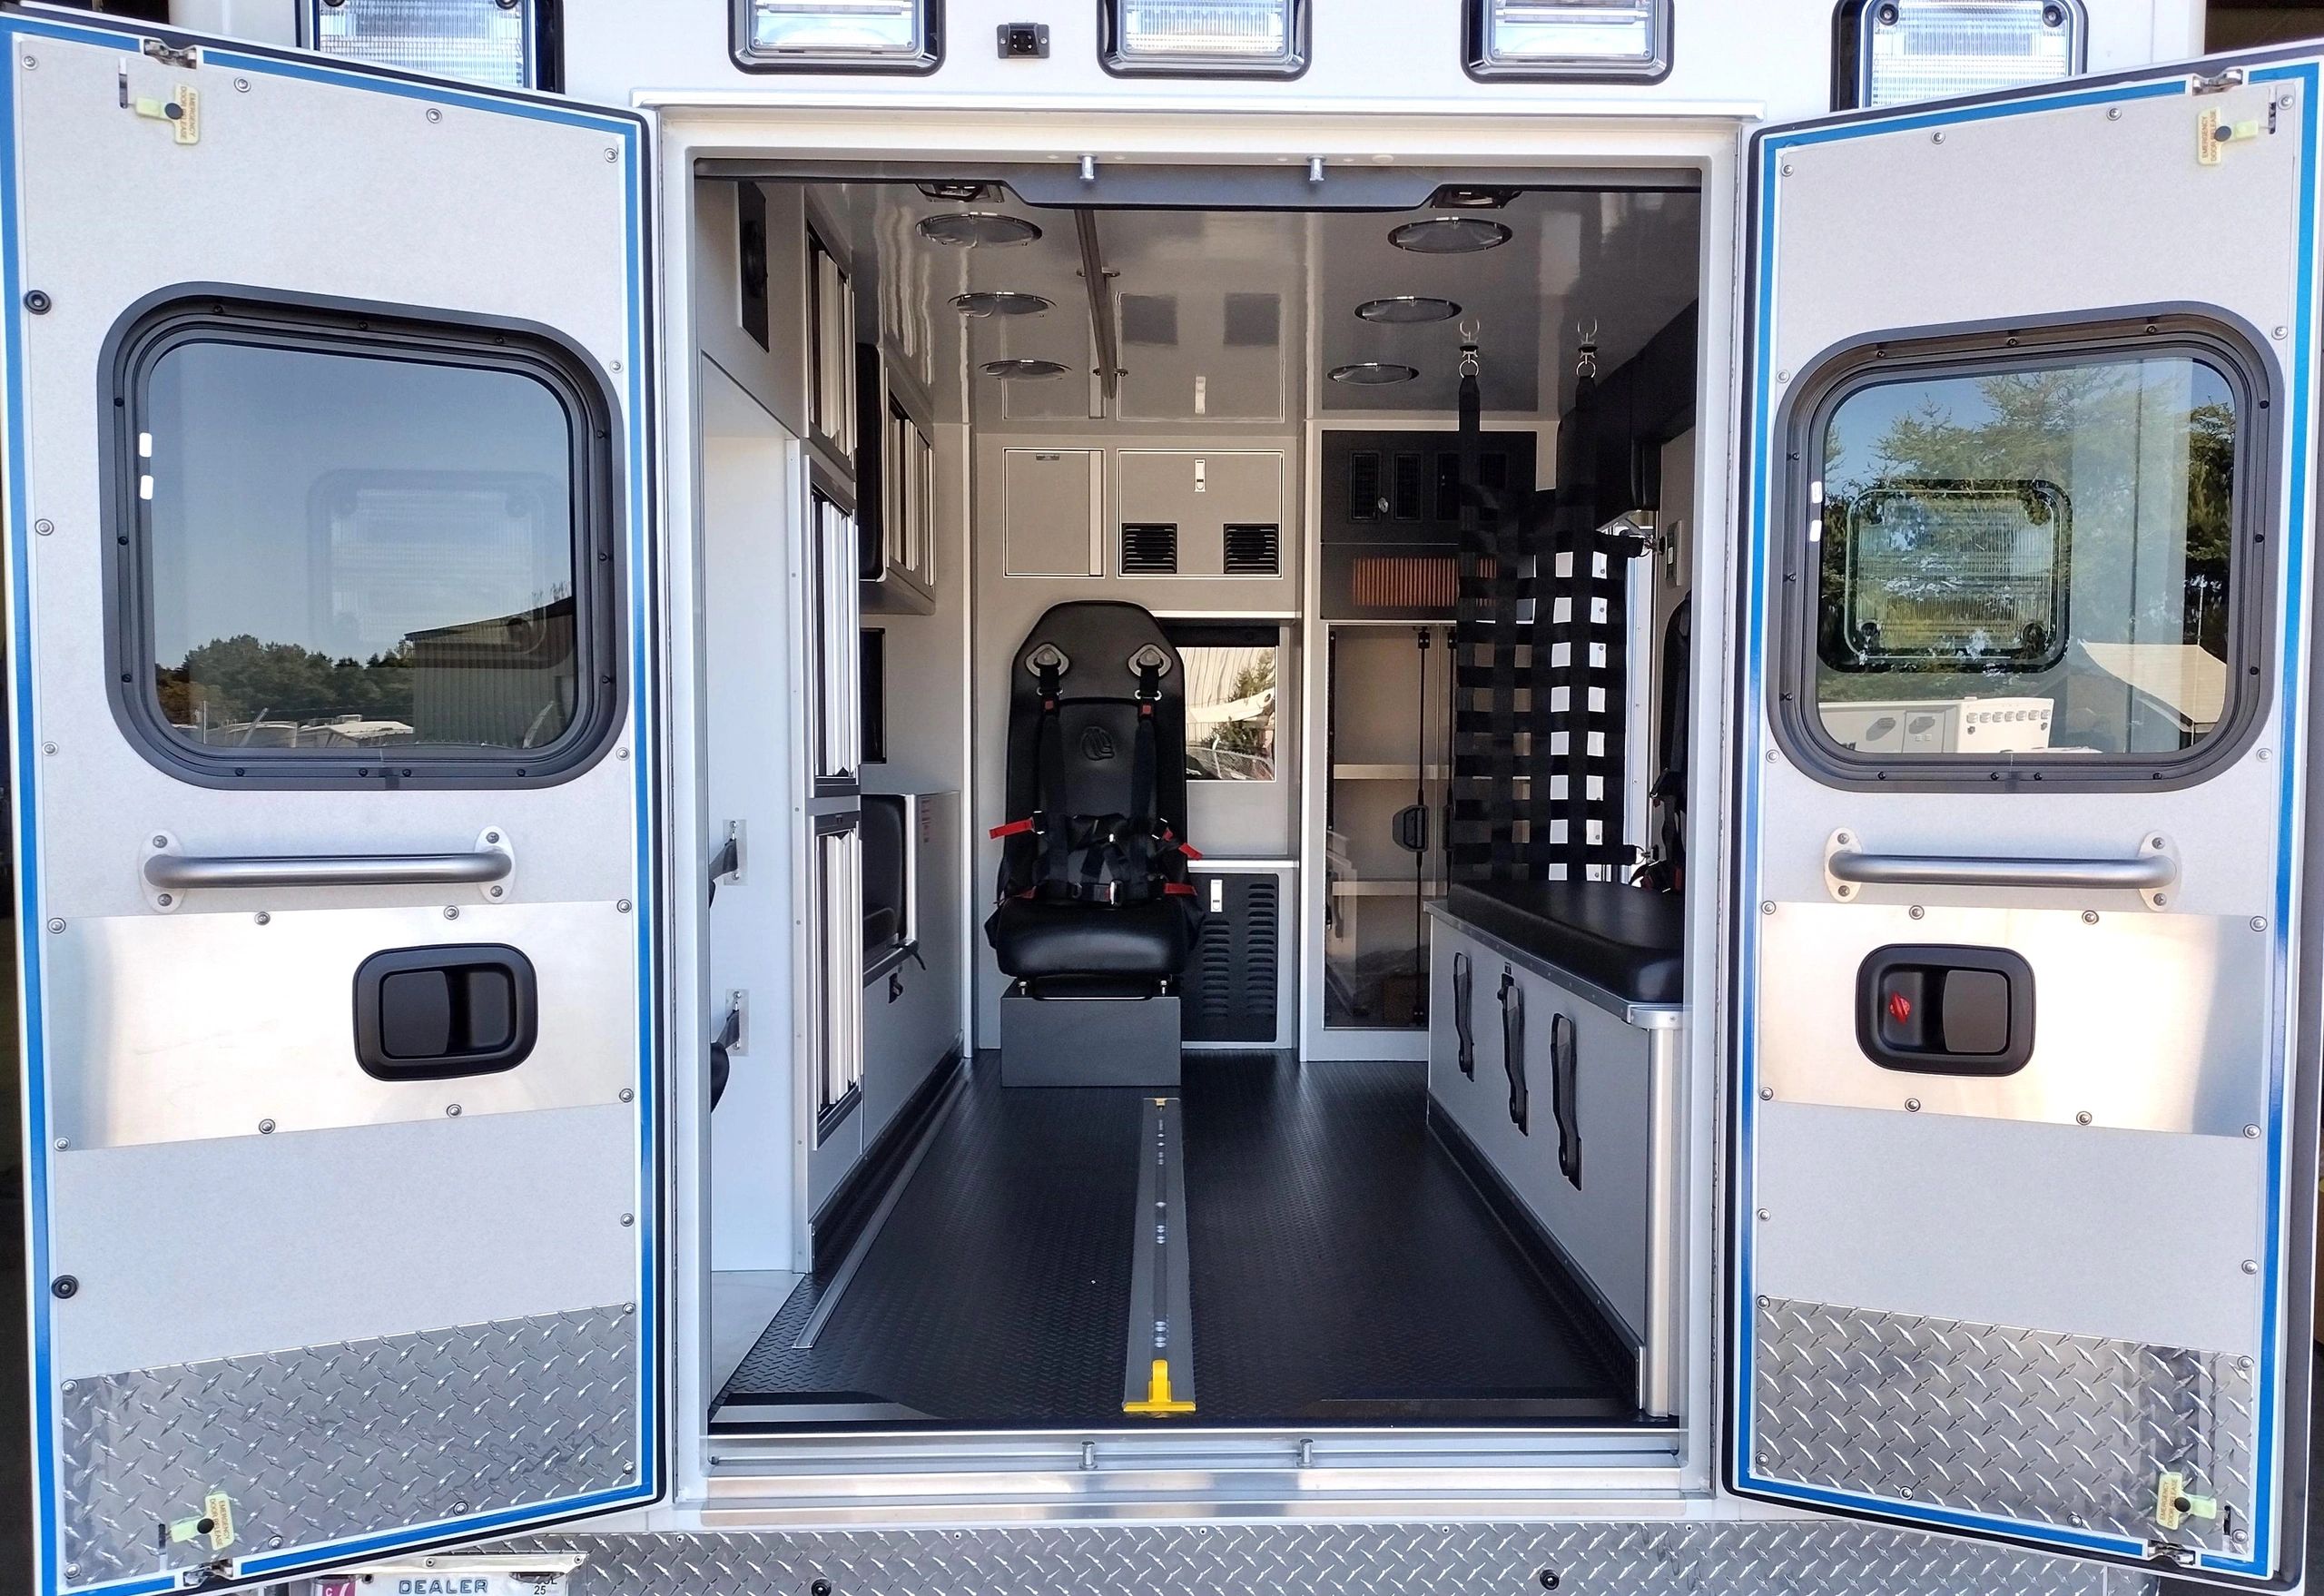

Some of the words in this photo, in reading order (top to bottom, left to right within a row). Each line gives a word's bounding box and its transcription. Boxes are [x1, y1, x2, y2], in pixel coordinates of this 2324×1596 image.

[209, 1498, 218, 1518] DOOR
[2159, 1482, 2169, 1521] EMERGENCY
[219, 1501, 231, 1540] EMERGENCY
[2167, 1509, 2175, 1527] DOOR
[213, 1519, 223, 1547] RELEASE
[399, 1579, 487, 1595] DEALER
[534, 1585, 547, 1595] 25
